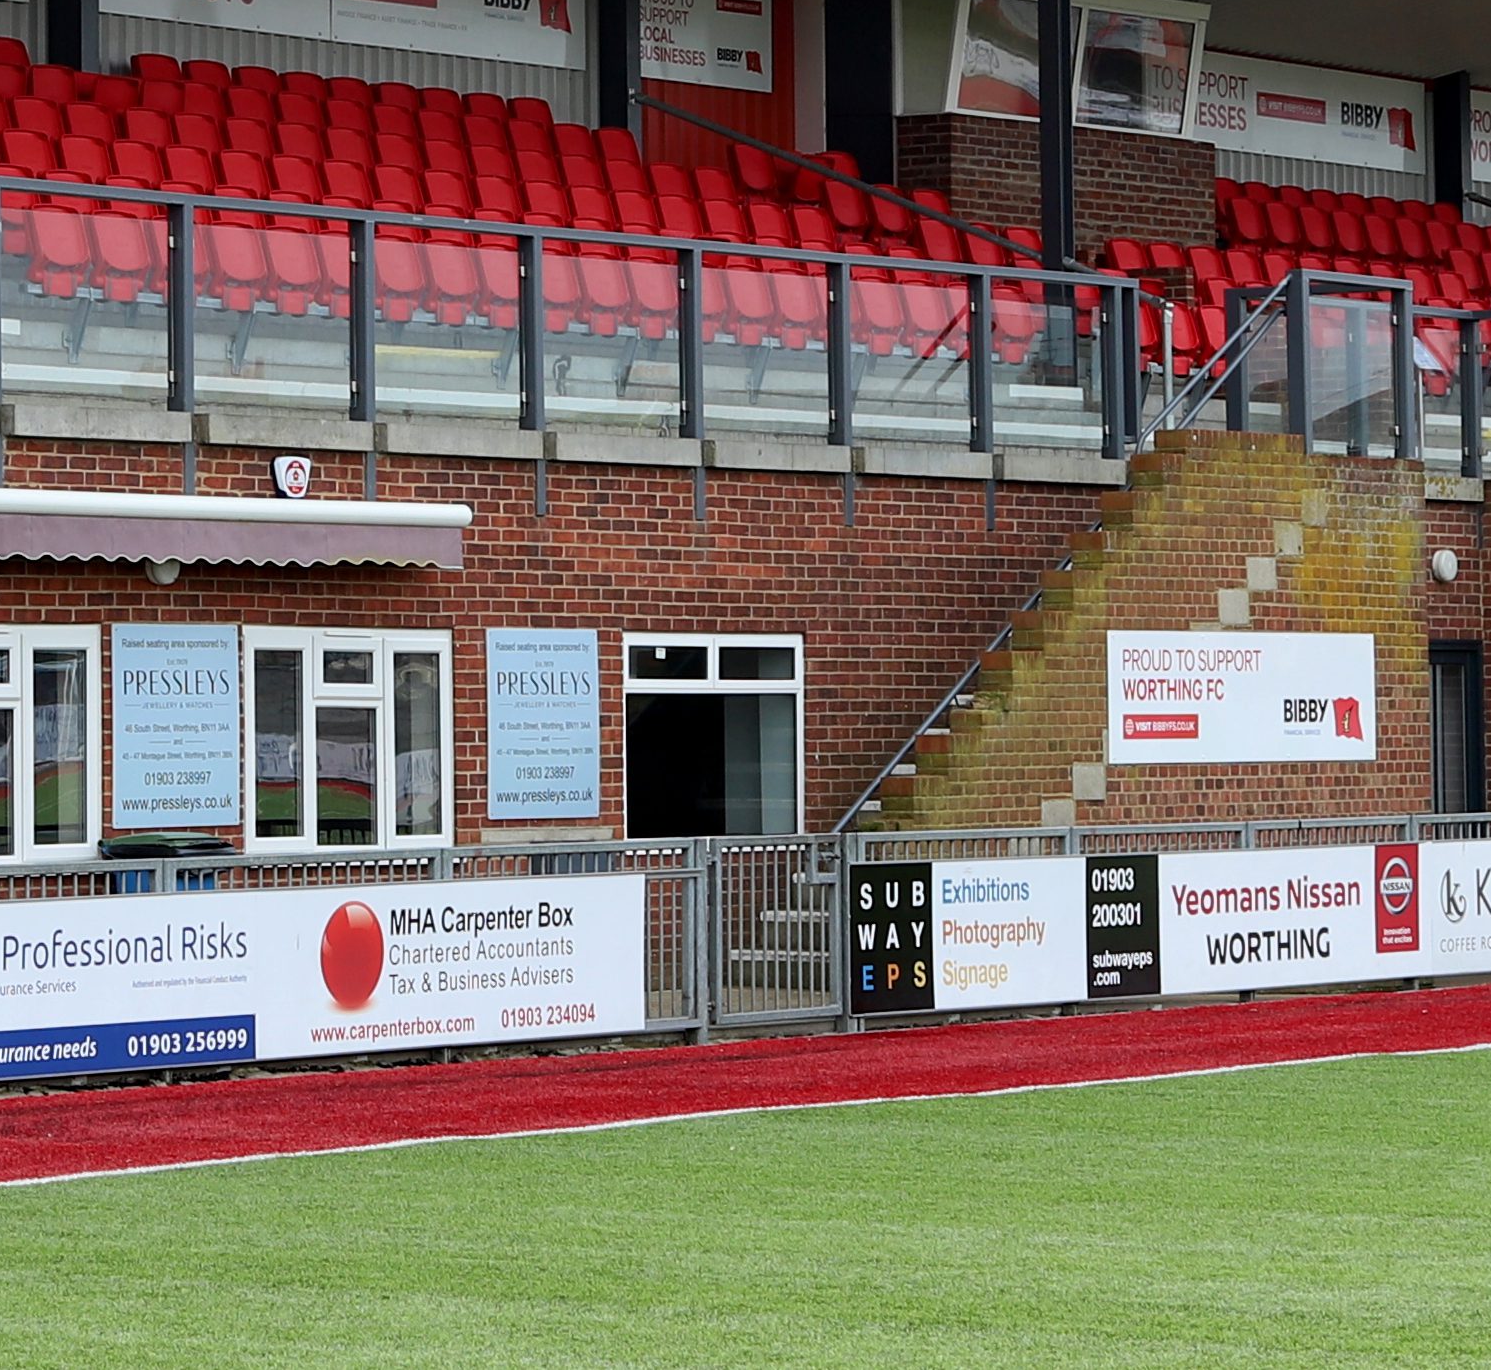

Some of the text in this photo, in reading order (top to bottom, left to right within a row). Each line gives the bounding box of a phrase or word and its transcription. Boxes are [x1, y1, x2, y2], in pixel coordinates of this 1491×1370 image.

[717, 48, 743, 62] BIBBY
[1341, 101, 1383, 129] BIBBY
[1122, 649, 1261, 671] PROUD TO SUPPORT
[124, 670, 229, 695] PRESSLEYS
[497, 672, 590, 695] PRESSLEYS
[1122, 679, 1224, 701] WORTHING FC
[1283, 699, 1329, 722] BIBBY
[122, 794, 232, 813] www.pressleys.co.uk
[497, 788, 593, 805] www.pressleys.co.uk
[942, 878, 1030, 904] Exhibitions
[1092, 867, 1134, 892] 01903
[1172, 875, 1360, 916] Yeomans Nissan
[390, 902, 574, 938] MHA Carpenter Box
[1092, 902, 1142, 928] 200301
[942, 916, 1046, 948] Photography
[1440, 937, 1476, 953] COFFEE
[3, 924, 173, 971] Professional
[182, 922, 247, 961] Risks
[389, 937, 574, 966] Chartered Accountants
[1207, 927, 1330, 966] WORTHING
[1092, 950, 1153, 971] subwayeps
[36, 979, 77, 994] Services
[389, 966, 574, 996] Tax & Business Advisers
[942, 960, 1008, 991] Signage
[311, 1003, 596, 1043] www.carpenterbox.com 01903 234094
[53, 1036, 97, 1059] needs
[128, 1033, 181, 1057] 01903
[186, 1028, 247, 1054] 256999
